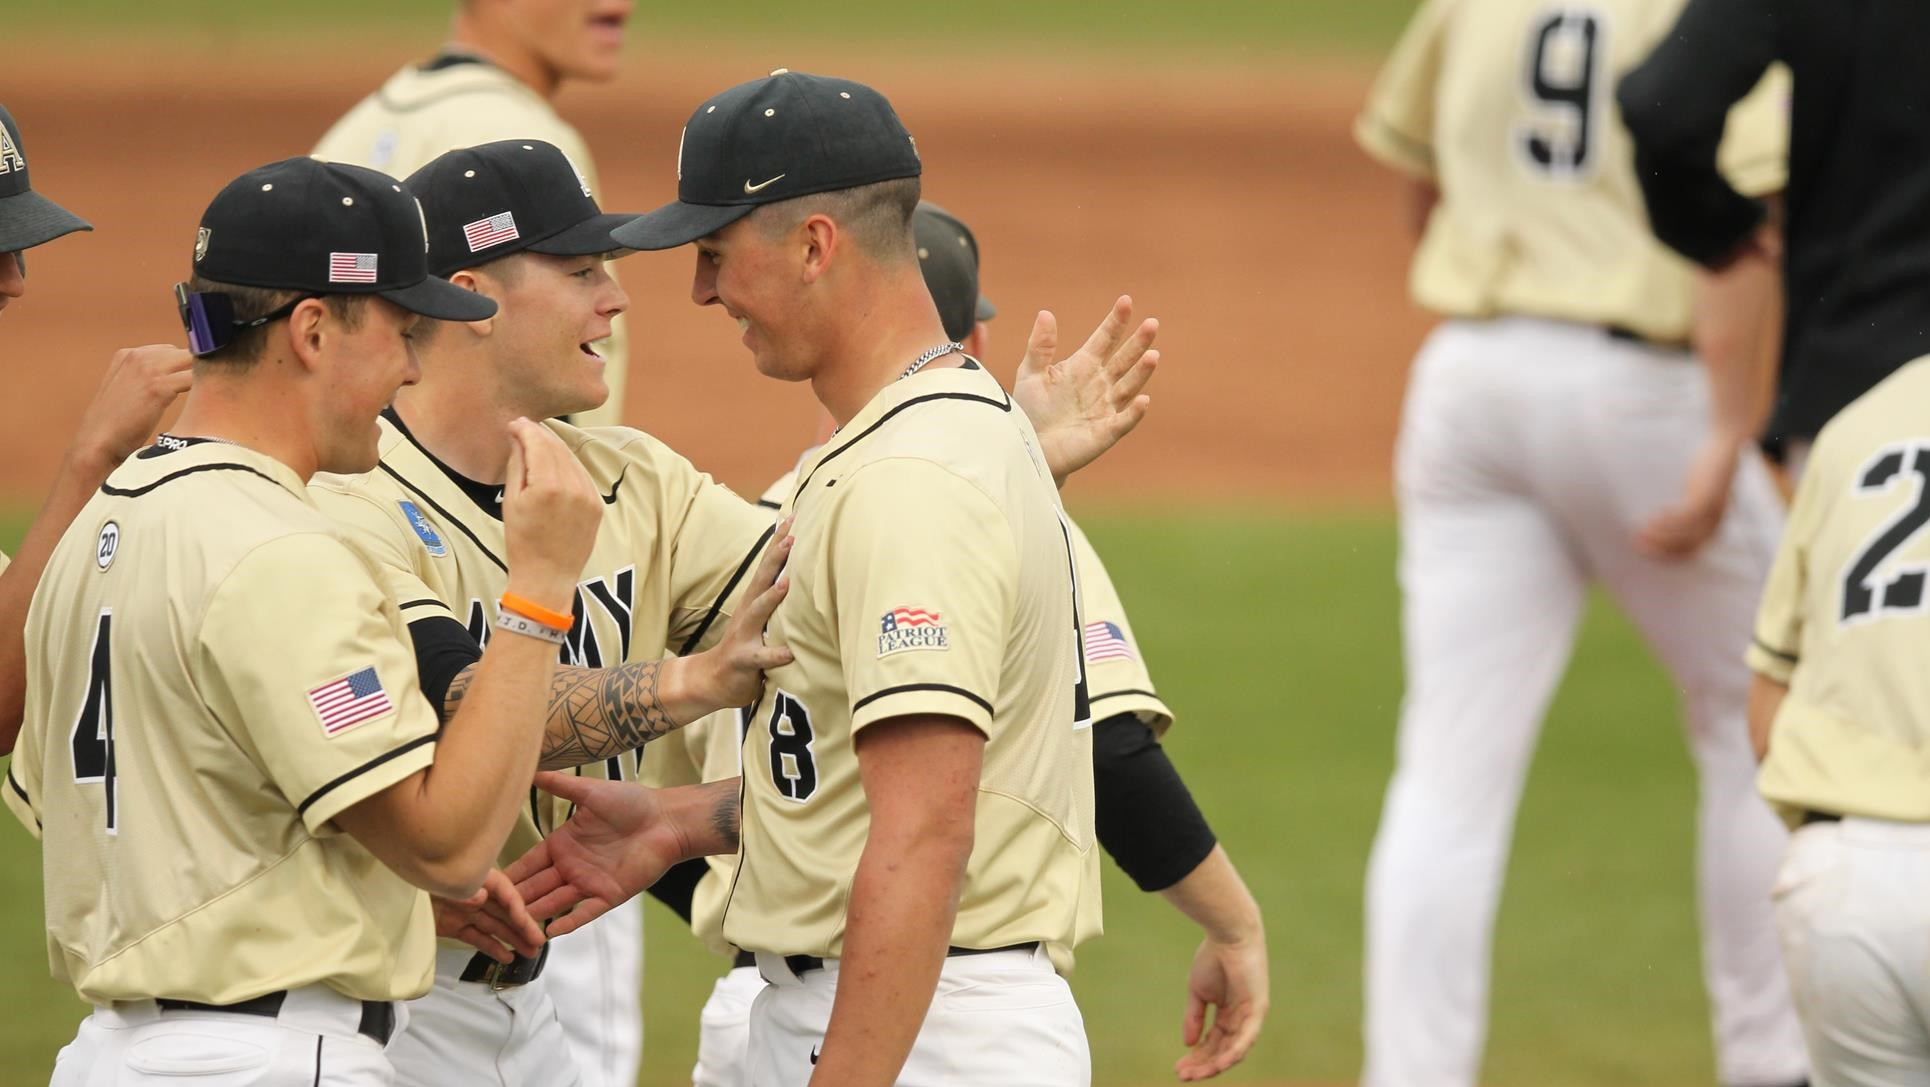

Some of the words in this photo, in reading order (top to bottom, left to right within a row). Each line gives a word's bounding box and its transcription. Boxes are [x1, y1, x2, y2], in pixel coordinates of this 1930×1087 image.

[1524, 12, 1602, 172] 9
[0, 120, 25, 174] A
[100, 532, 115, 557] 20
[1839, 443, 1930, 620] 2
[879, 626, 947, 645] PATRIOT
[879, 636, 948, 654] LEAGUE
[69, 606, 117, 836] 4
[768, 688, 818, 804] 8
